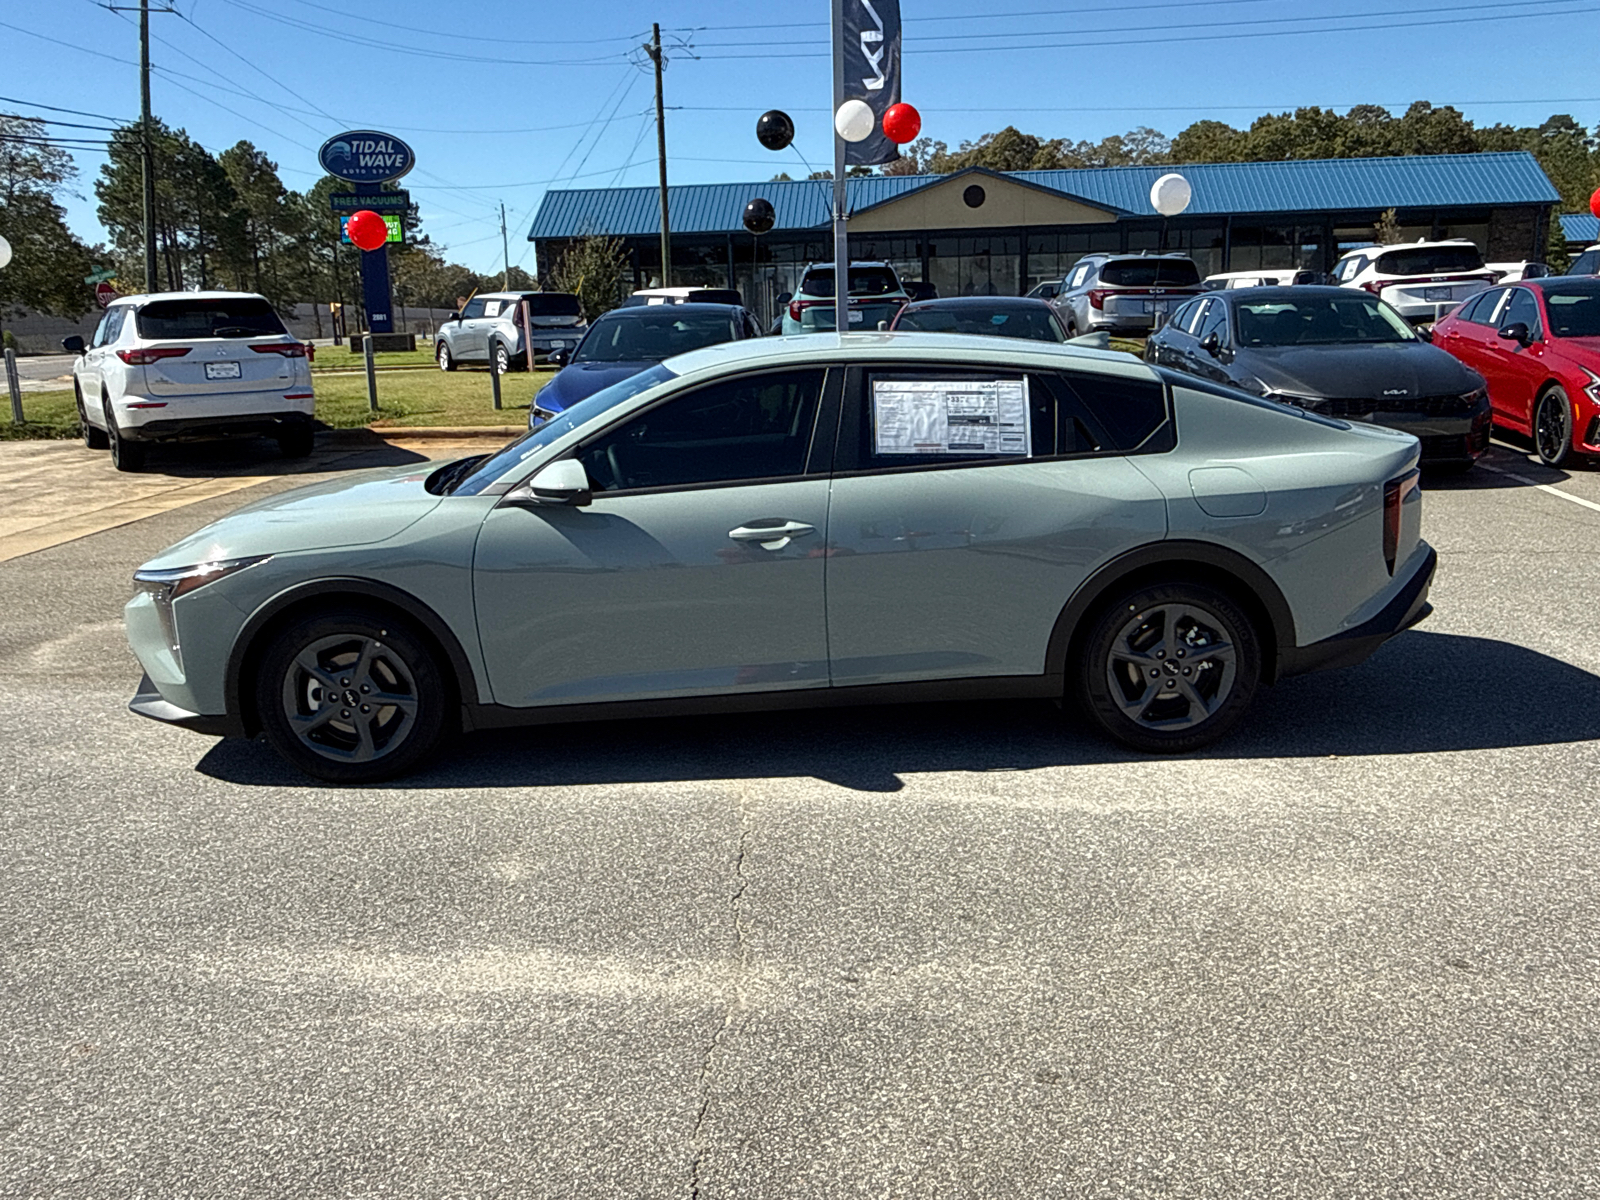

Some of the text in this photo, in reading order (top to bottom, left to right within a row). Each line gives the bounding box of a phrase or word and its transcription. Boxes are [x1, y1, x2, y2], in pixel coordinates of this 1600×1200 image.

[351, 140, 395, 153] TIDAL
[359, 154, 404, 167] WAVE
[333, 195, 403, 206] FREE VACUUMS
